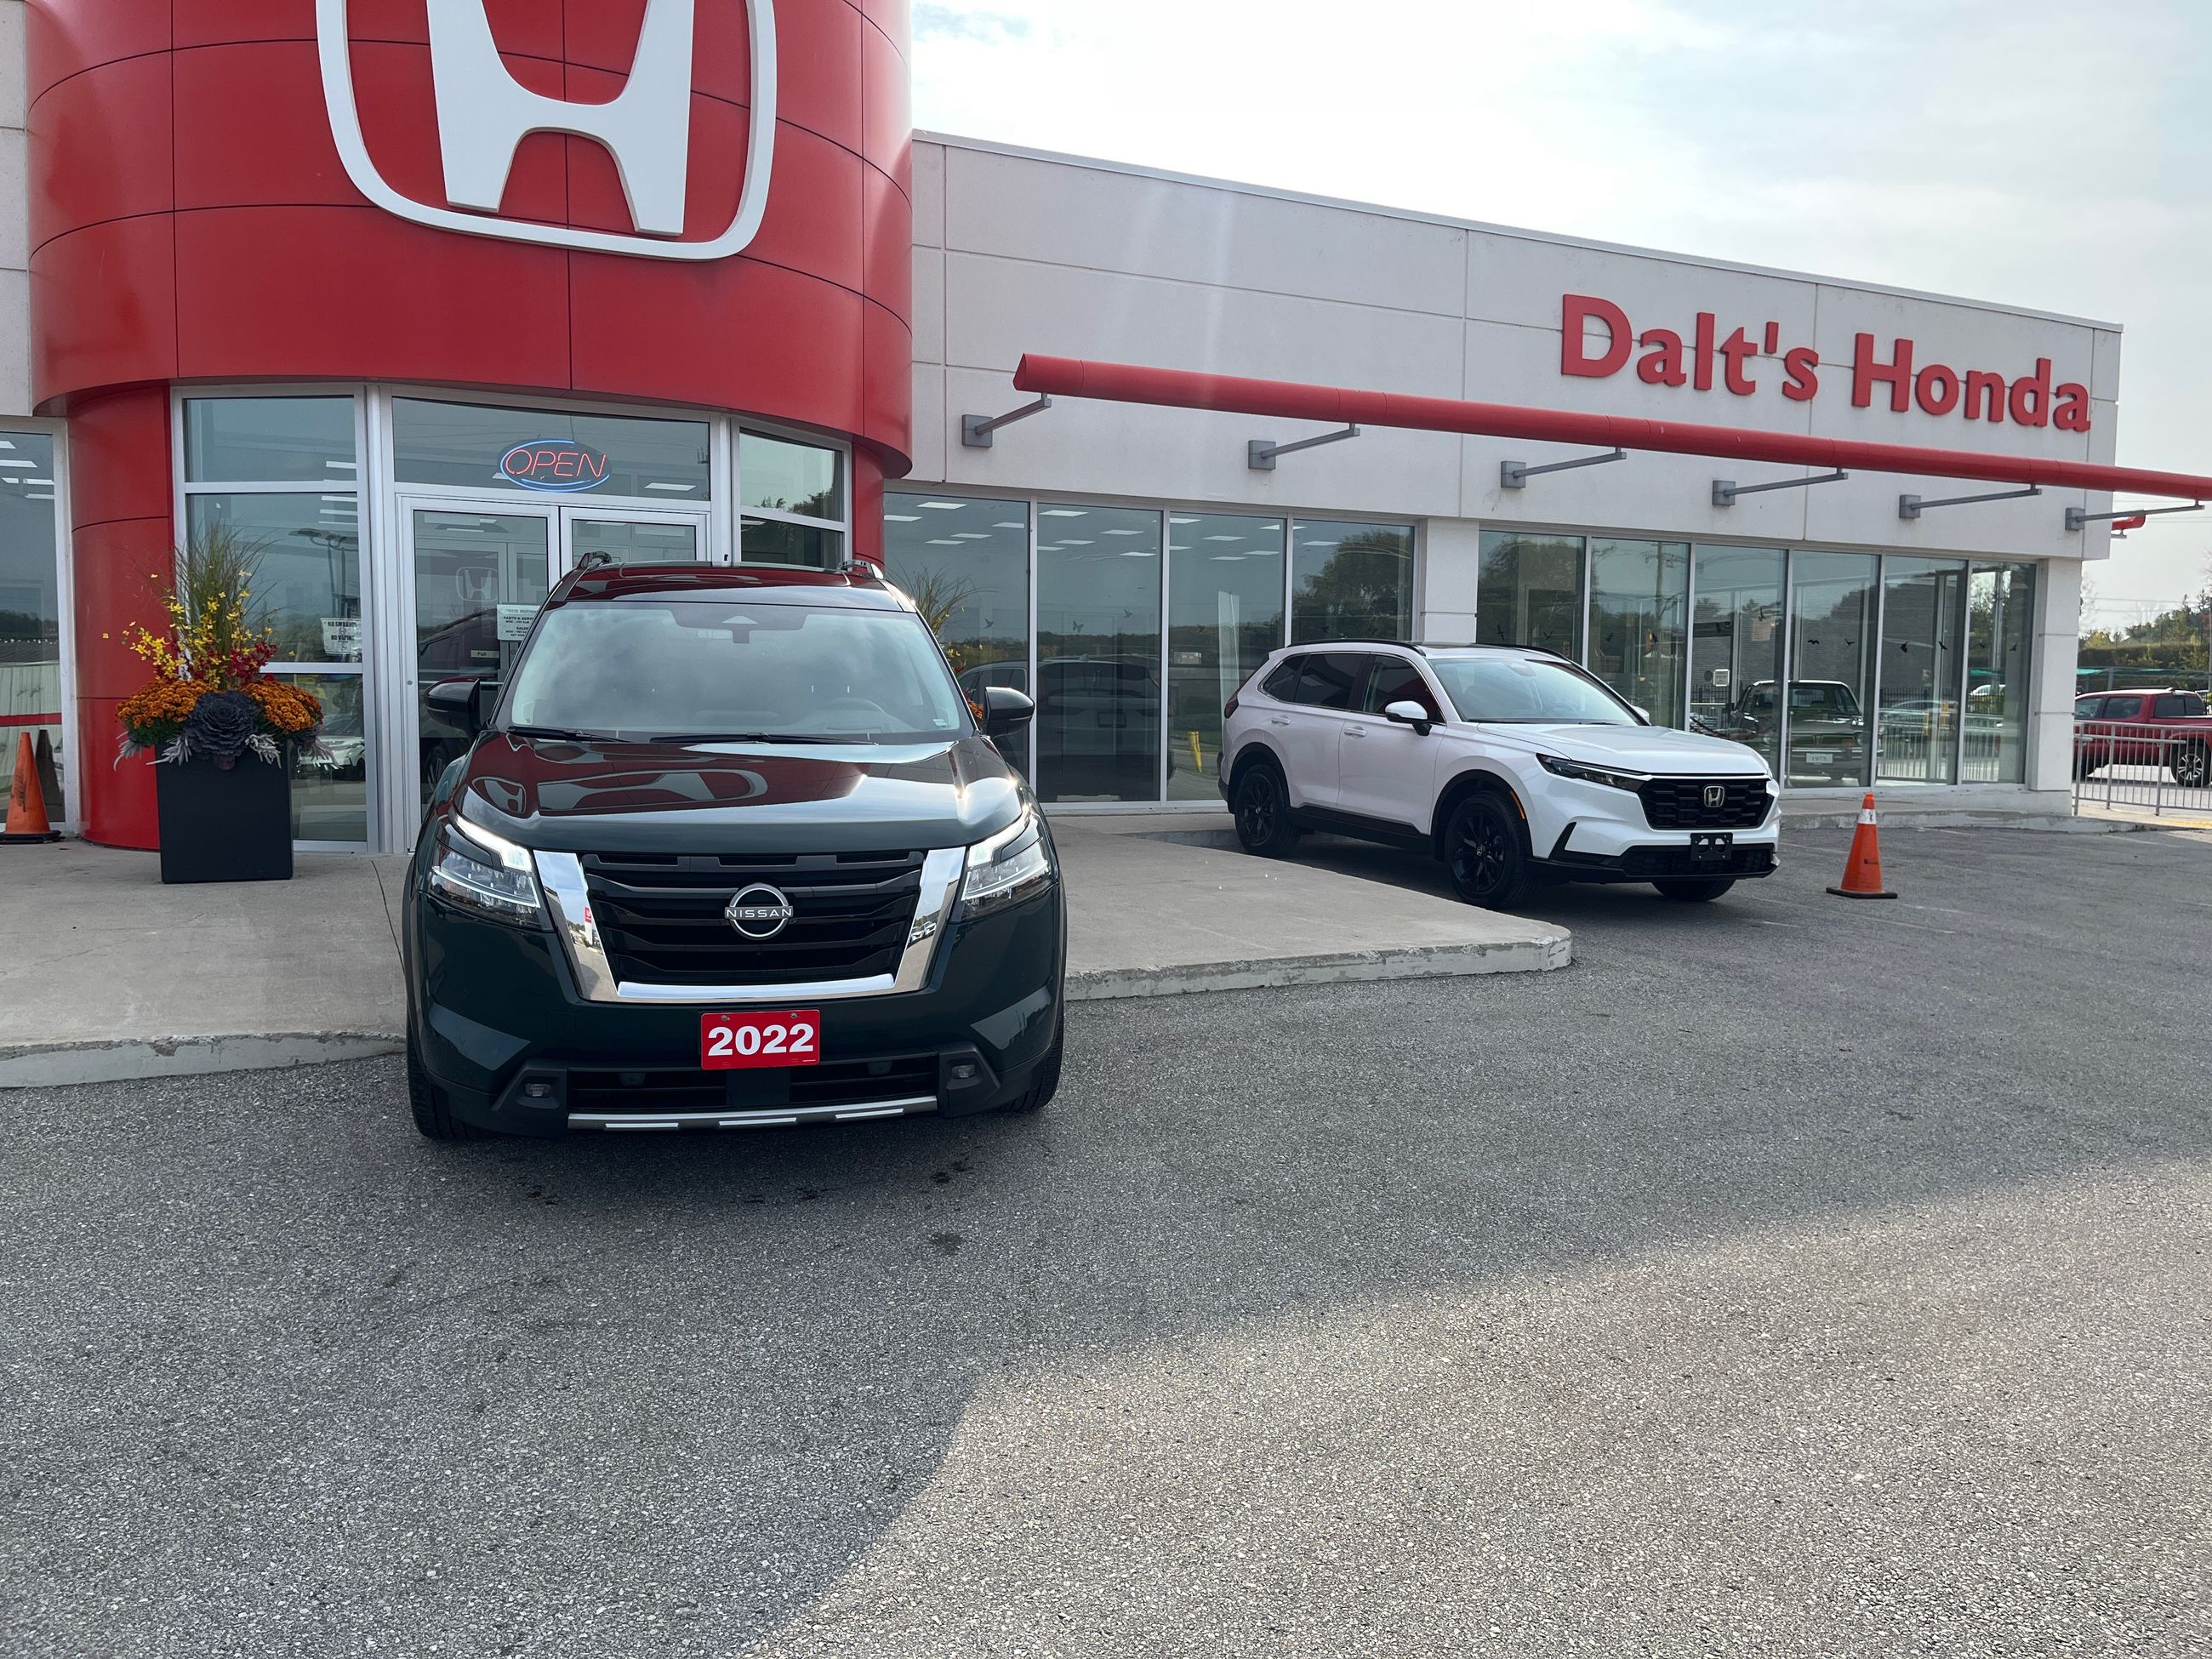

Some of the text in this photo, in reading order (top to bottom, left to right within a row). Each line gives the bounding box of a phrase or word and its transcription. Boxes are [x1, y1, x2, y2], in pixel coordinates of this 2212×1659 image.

[1561, 294, 2091, 432] Dalt's Honda
[505, 449, 607, 476] OPEN
[727, 908, 792, 918] NISSAN
[708, 1023, 814, 1056] 2022
